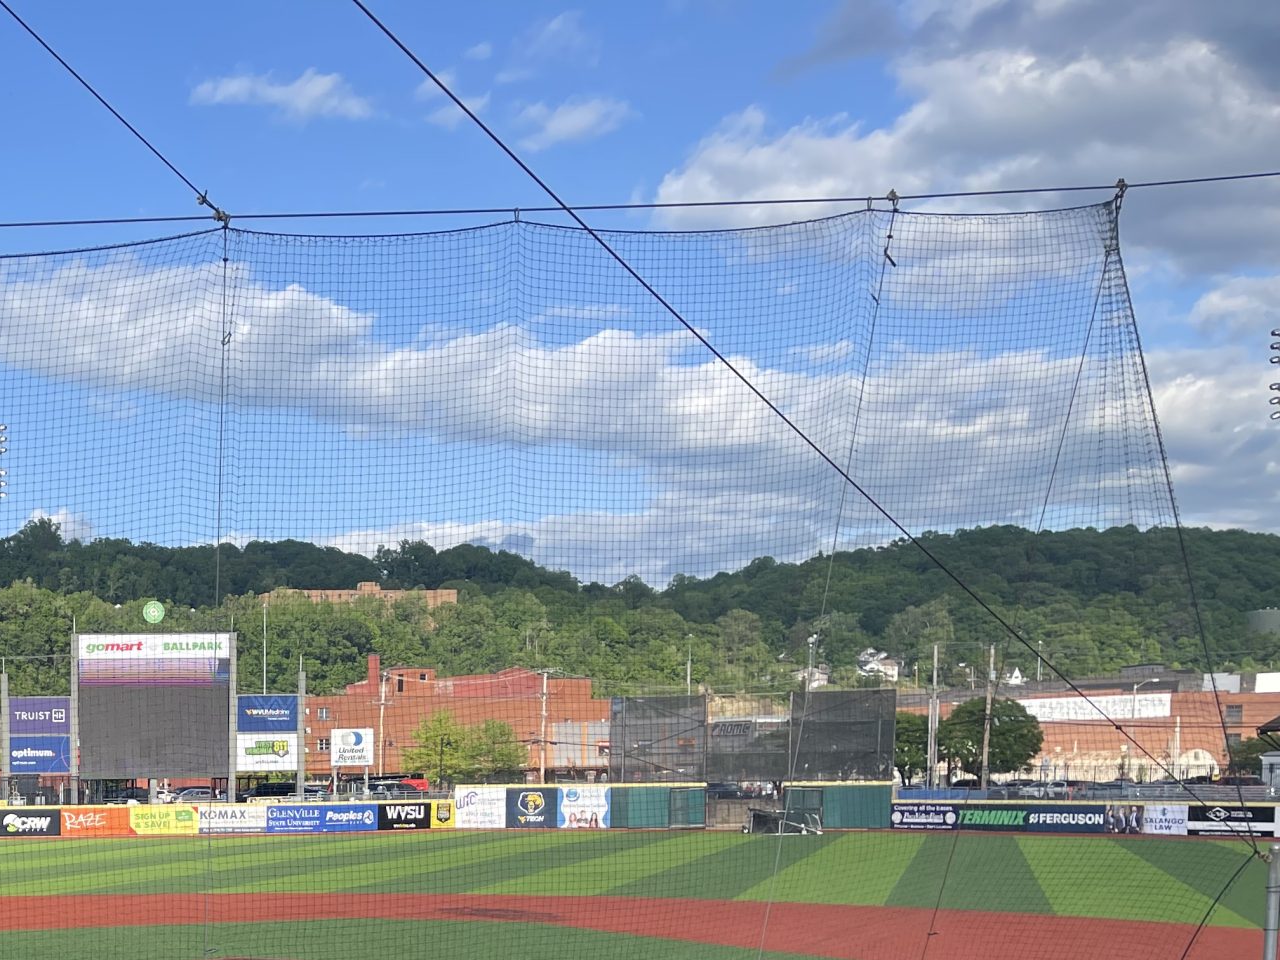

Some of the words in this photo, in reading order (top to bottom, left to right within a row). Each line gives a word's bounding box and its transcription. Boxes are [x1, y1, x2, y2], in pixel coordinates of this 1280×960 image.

[86, 641, 143, 653] gomart
[163, 641, 223, 651] BALLPARK
[14, 711, 51, 720] TRUIST
[273, 740, 288, 752] 811
[338, 746, 365, 754] United
[338, 753, 366, 761] Rentals
[200, 810, 246, 820] KOMAX
[267, 807, 321, 819] GLENVILLE
[325, 810, 363, 822] Peoples
[385, 805, 425, 821] WVSU
[957, 810, 1027, 825] TERMINIX
[1039, 813, 1104, 825] FERGUSON
[17, 815, 51, 829] CRW
[62, 812, 108, 830] RAZE
[1144, 817, 1184, 825] SALANGO
